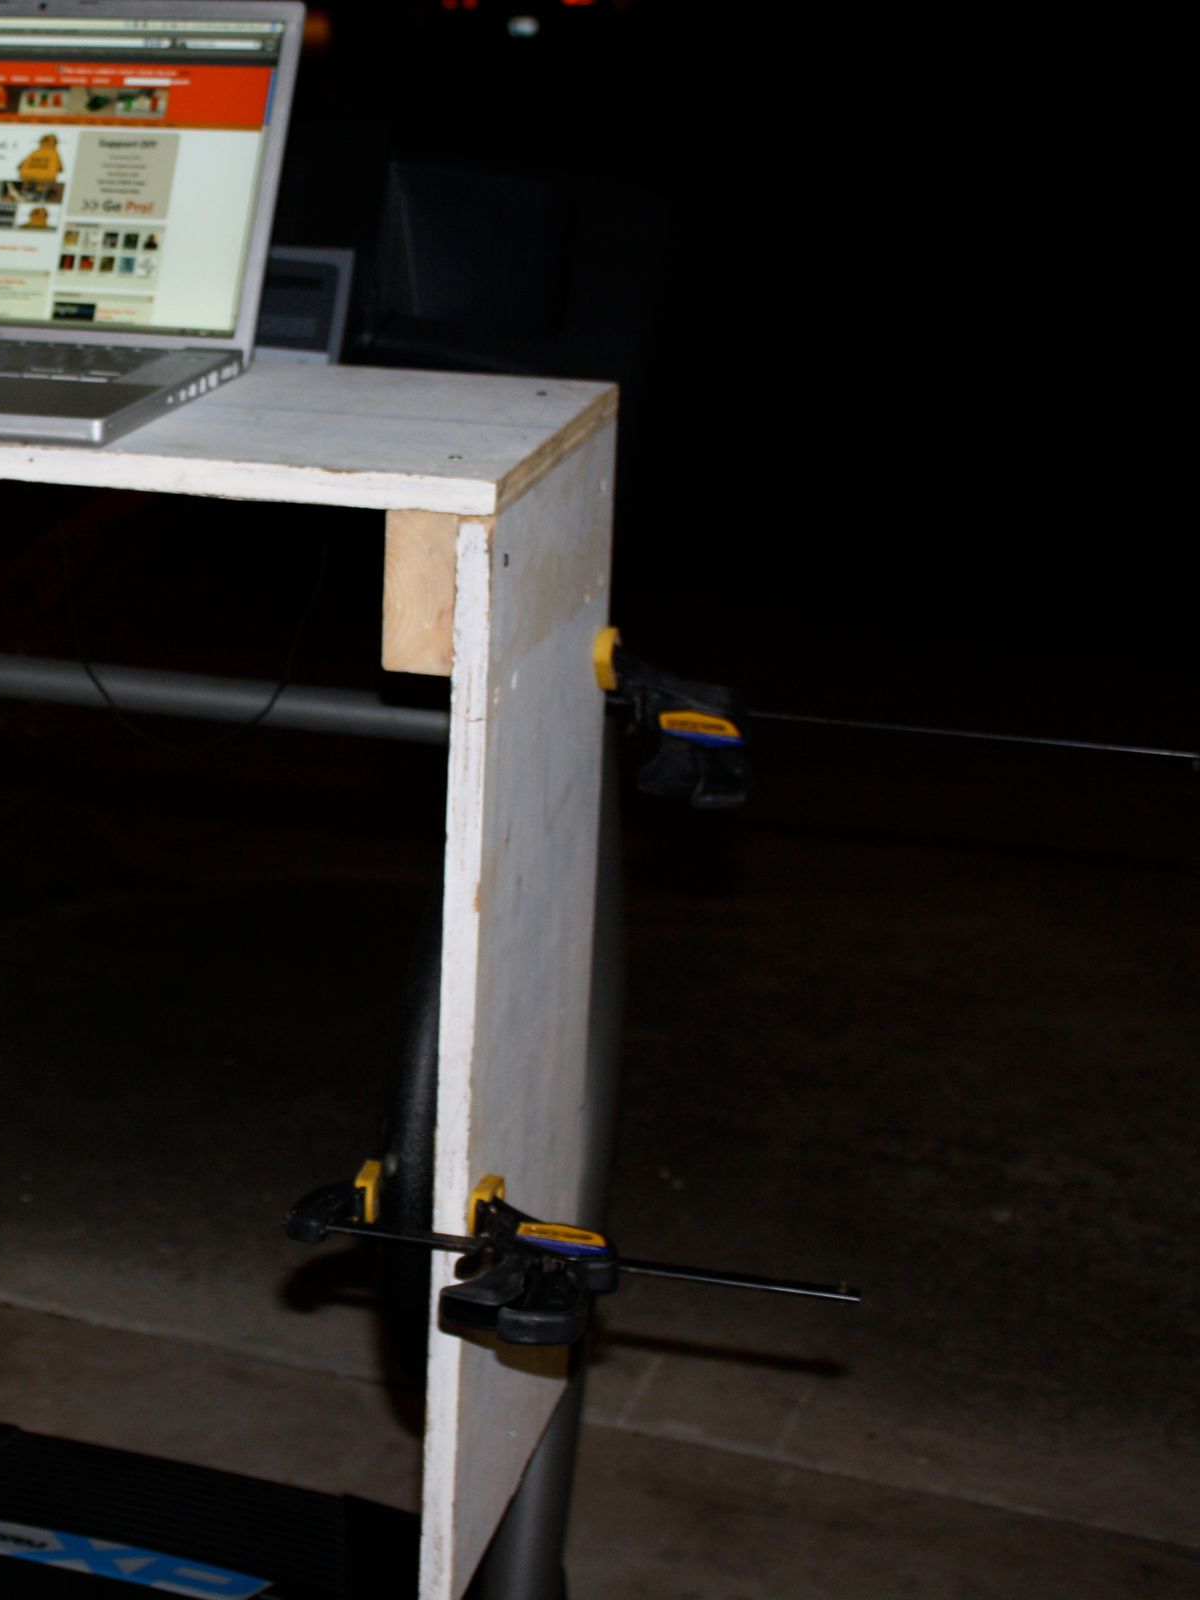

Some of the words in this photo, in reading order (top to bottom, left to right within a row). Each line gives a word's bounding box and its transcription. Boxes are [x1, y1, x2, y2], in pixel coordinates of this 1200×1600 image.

[98, 138, 138, 149] Support
[102, 199, 122, 212] Go
[125, 200, 155, 214] Pro!
